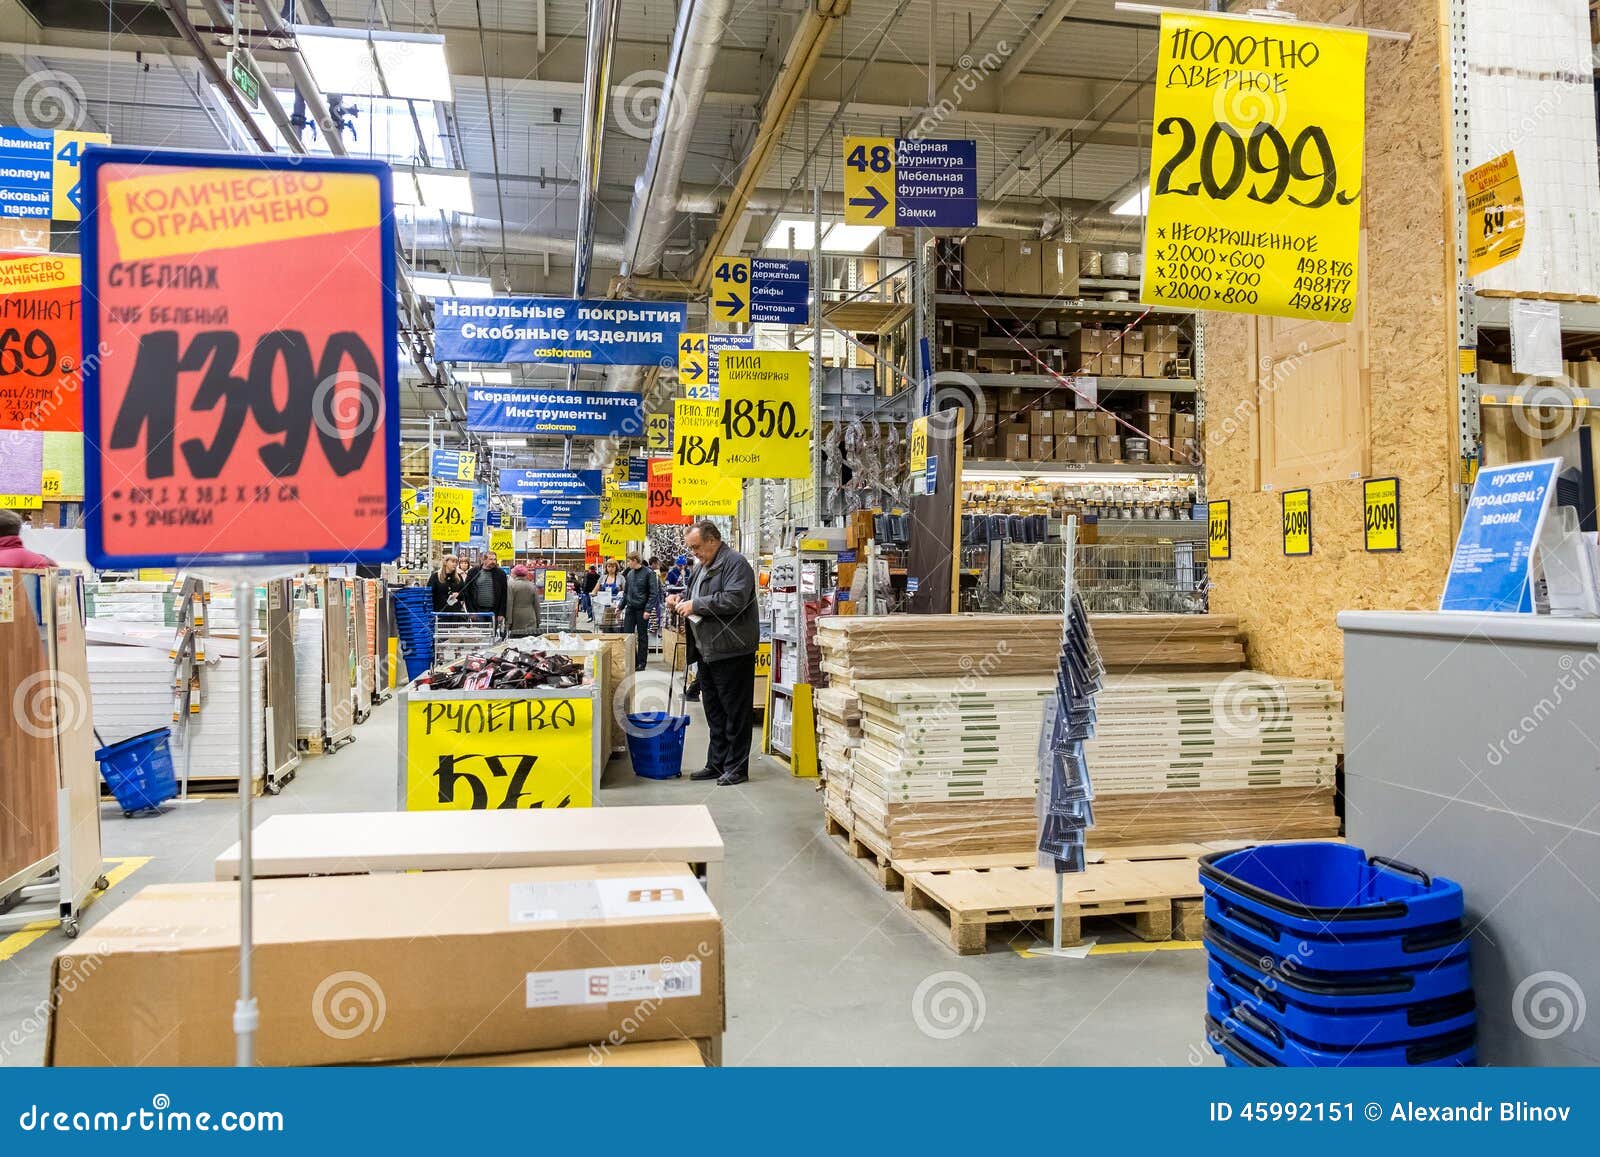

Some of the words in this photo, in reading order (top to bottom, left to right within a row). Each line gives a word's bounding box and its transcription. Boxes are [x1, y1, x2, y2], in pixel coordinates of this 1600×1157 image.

[1172, 28, 1319, 68] ПОЛОТНО
[1166, 64, 1288, 94] ДВЕРНОЕ
[56, 141, 80, 167] 4
[898, 140, 948, 153] Дверная
[846, 145, 892, 174] 48
[898, 154, 964, 167] фурнитура
[0, 168, 50, 181] нолеум
[898, 170, 963, 182] Мебельная
[0, 189, 50, 203] бковый
[124, 173, 325, 216] КОЛИЧЕСТВО
[898, 183, 965, 197] фурнитура
[3, 204, 50, 216] паркет
[130, 196, 329, 240] ОГРАНИЧЕНО
[898, 206, 937, 218] Замки
[1171, 222, 1318, 253] НЕОКРАШЕННОЕ
[715, 262, 748, 284] 46
[752, 260, 789, 271] Крепеж,
[1297, 257, 1353, 277] 498176
[108, 262, 220, 290] СТЕЛЛАЖ
[752, 270, 800, 281] держатели
[752, 286, 784, 297] Сейфы
[1293, 276, 1352, 295] 498177
[751, 303, 795, 313] Почтовые
[1288, 292, 1352, 314] 498178
[442, 301, 566, 320] Напольные
[577, 306, 682, 325] покрытия
[751, 313, 780, 322] ящики
[461, 324, 570, 342] Скобяные
[575, 330, 664, 345] изделия
[534, 347, 593, 360] castorama
[680, 338, 706, 354] 44
[725, 356, 761, 370] ПИЛА
[474, 390, 583, 407] Керамическая
[586, 397, 639, 408] плитка
[687, 386, 711, 399] 42
[109, 329, 384, 480] 1390
[505, 407, 608, 423] Инструменты
[535, 423, 577, 432] castorama
[650, 418, 668, 430] 40
[677, 435, 720, 467] 184
[460, 456, 475, 464] 37
[615, 458, 629, 467] 36
[526, 471, 578, 479] Сантехника
[1491, 470, 1534, 488] нужен
[517, 480, 586, 489] Электротовары
[1471, 486, 1545, 509] продавец?
[1285, 511, 1308, 535] 2099
[1367, 503, 1395, 531] 2099
[1480, 509, 1522, 526] звони!
[547, 580, 563, 593] 599
[423, 700, 576, 735] РУЛЕТКА
